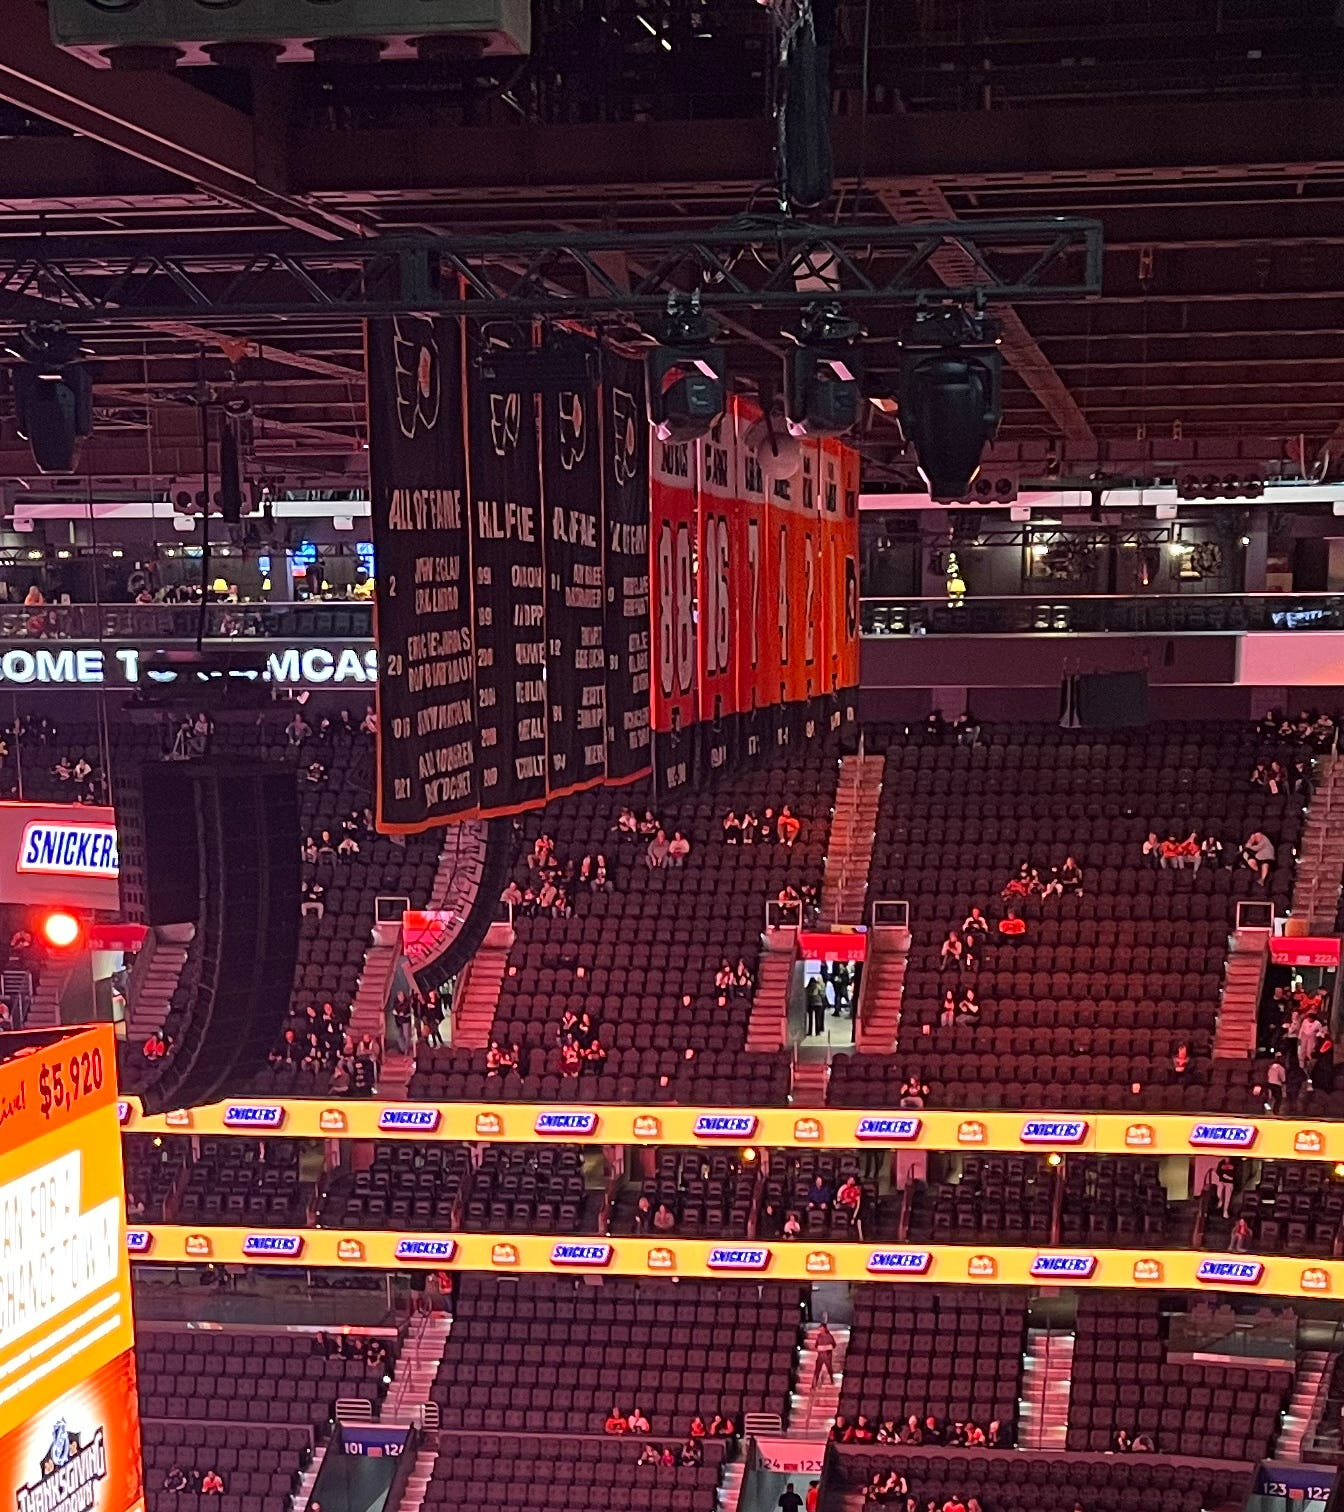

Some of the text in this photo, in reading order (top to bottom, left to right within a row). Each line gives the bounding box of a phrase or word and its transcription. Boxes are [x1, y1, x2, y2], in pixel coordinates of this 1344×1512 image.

[706, 512, 730, 676] 16
[659, 518, 693, 699] 88
[38, 1047, 104, 1121] $5,920
[383, 1111, 434, 1125] SNICKERS
[698, 1117, 750, 1131] SNICKERS
[1025, 1123, 1080, 1138] SNICKERS
[246, 1237, 296, 1251] SNICKERS
[555, 1246, 605, 1260] SNICKERS
[872, 1253, 924, 1267] SNICKERS
[1201, 1262, 1256, 1278] SNICKERS
[344, 1442, 363, 1456] 101
[758, 1458, 822, 1472] 124 123
[1263, 1482, 1331, 1501] 123 122
